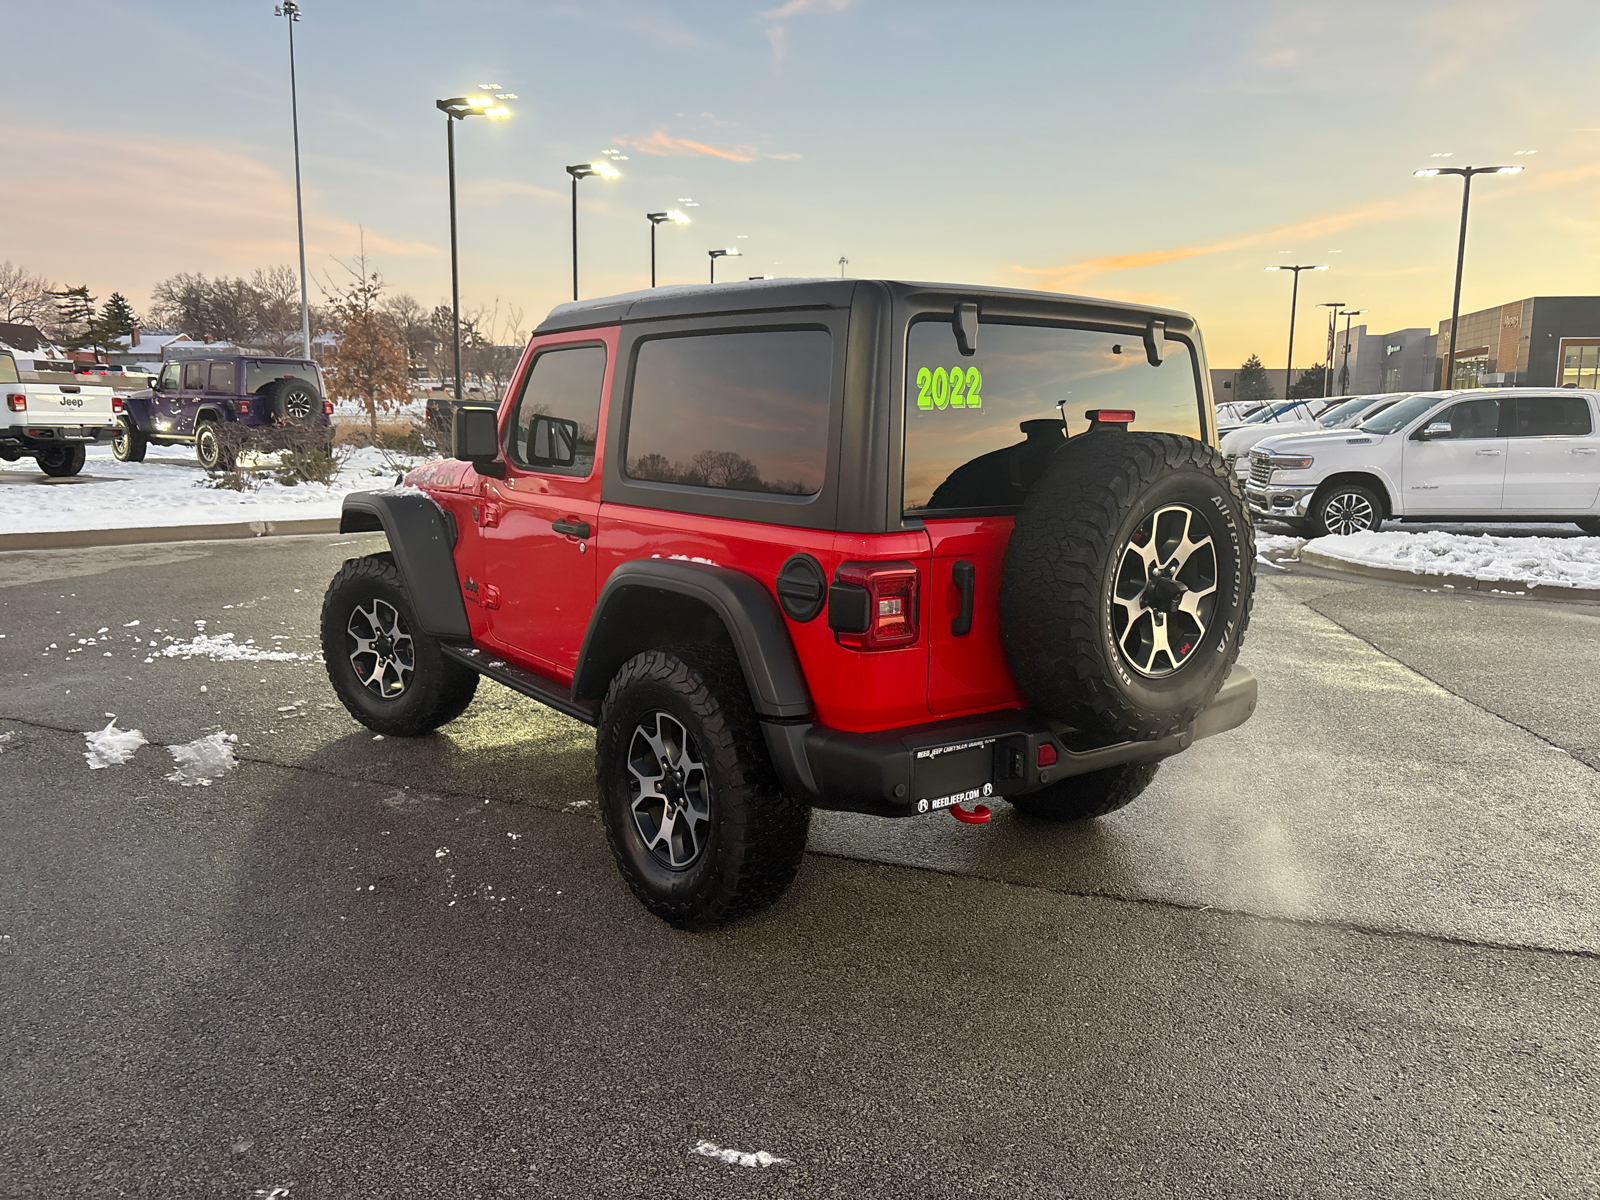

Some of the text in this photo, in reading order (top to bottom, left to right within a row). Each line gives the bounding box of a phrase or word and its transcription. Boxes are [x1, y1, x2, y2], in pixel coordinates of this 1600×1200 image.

[917, 366, 982, 410] 2022
[60, 396, 83, 408] Jeep
[1211, 495, 1241, 653] All-Terrain T/A
[917, 750, 930, 759] REED
[930, 747, 943, 757] JEEP
[932, 789, 980, 810] REEDJEEP.COM
